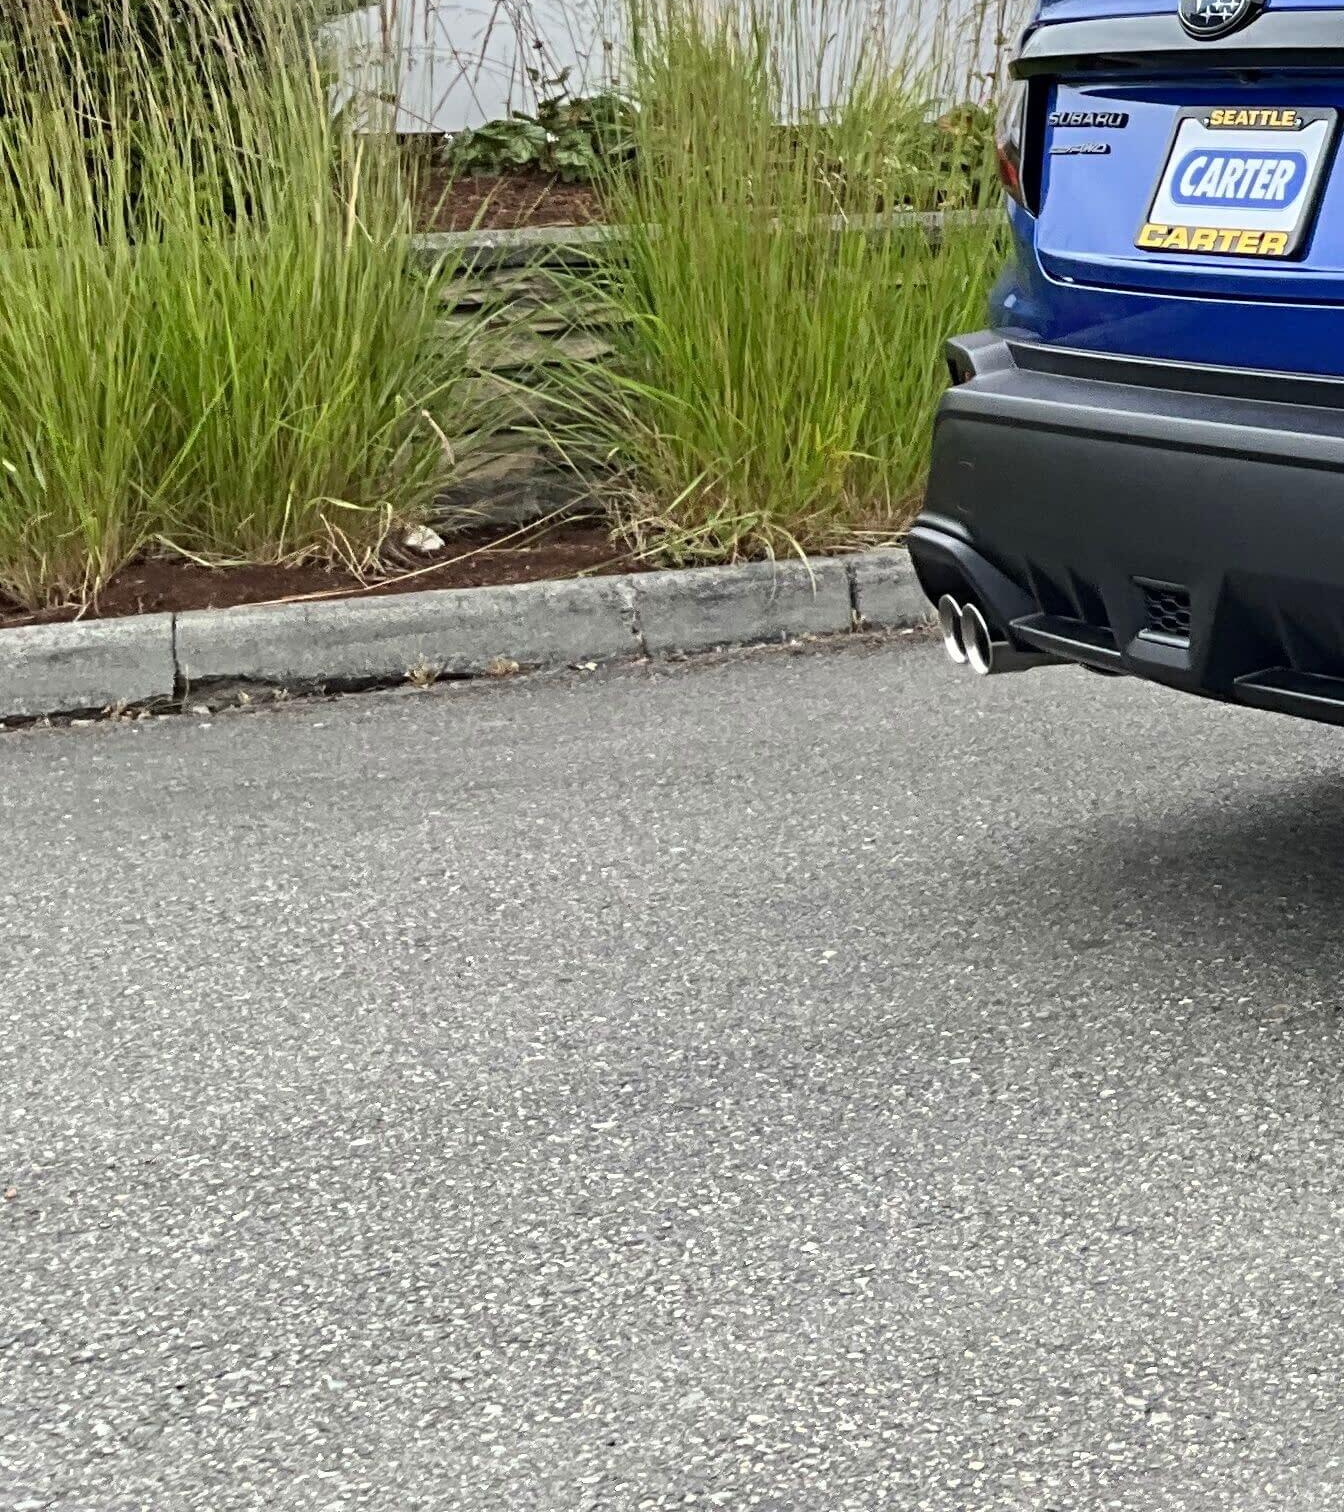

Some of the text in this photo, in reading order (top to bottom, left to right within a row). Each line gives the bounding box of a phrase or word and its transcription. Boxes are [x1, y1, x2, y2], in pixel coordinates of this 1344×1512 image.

[1049, 111, 1127, 127] SUBARU
[1209, 109, 1296, 126] SEATTLE
[1179, 155, 1297, 201] CARTER
[1137, 223, 1288, 255] CARTER
